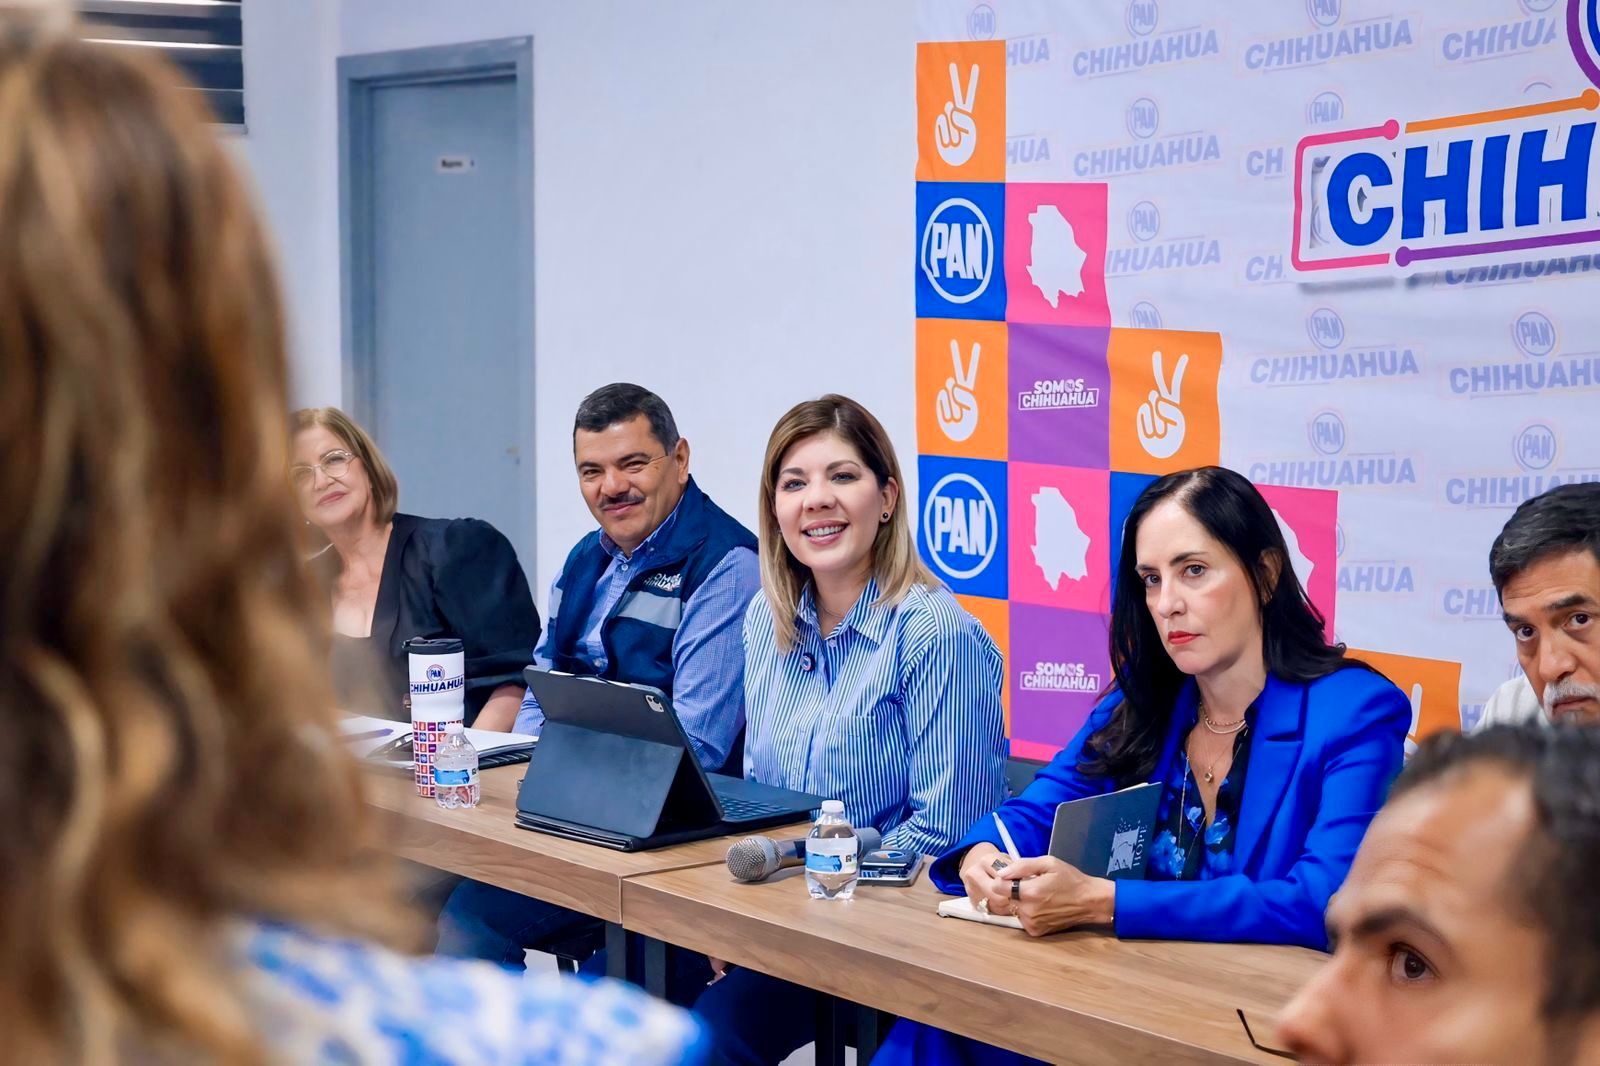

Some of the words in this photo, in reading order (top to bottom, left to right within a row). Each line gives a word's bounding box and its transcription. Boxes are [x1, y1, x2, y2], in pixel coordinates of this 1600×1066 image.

[1132, 4, 1155, 27] PAN
[1072, 29, 1219, 77] CHIHUAHUA
[1244, 19, 1413, 70] CHIHUAHUA
[1132, 107, 1156, 130] PAN
[1073, 134, 1221, 177] CHIHUAHUA
[1326, 121, 1597, 247] CHIH
[1134, 209, 1157, 233] PAN
[930, 222, 984, 280] PAN
[1245, 255, 1287, 282] CH
[1445, 253, 1600, 285] CHIHUAH
[1312, 316, 1342, 341] PAN
[1519, 320, 1552, 347] PAN
[1249, 349, 1420, 384] CHIHUAHUA
[1022, 391, 1096, 407] CHIHUAHUA
[1316, 421, 1341, 446] PAN
[1521, 434, 1552, 460] PAN
[1248, 457, 1417, 487] CHIHUAHUA
[934, 495, 987, 557] PAN
[1443, 588, 1503, 616] CHI
[1023, 674, 1096, 691] CHIHUAHUA
